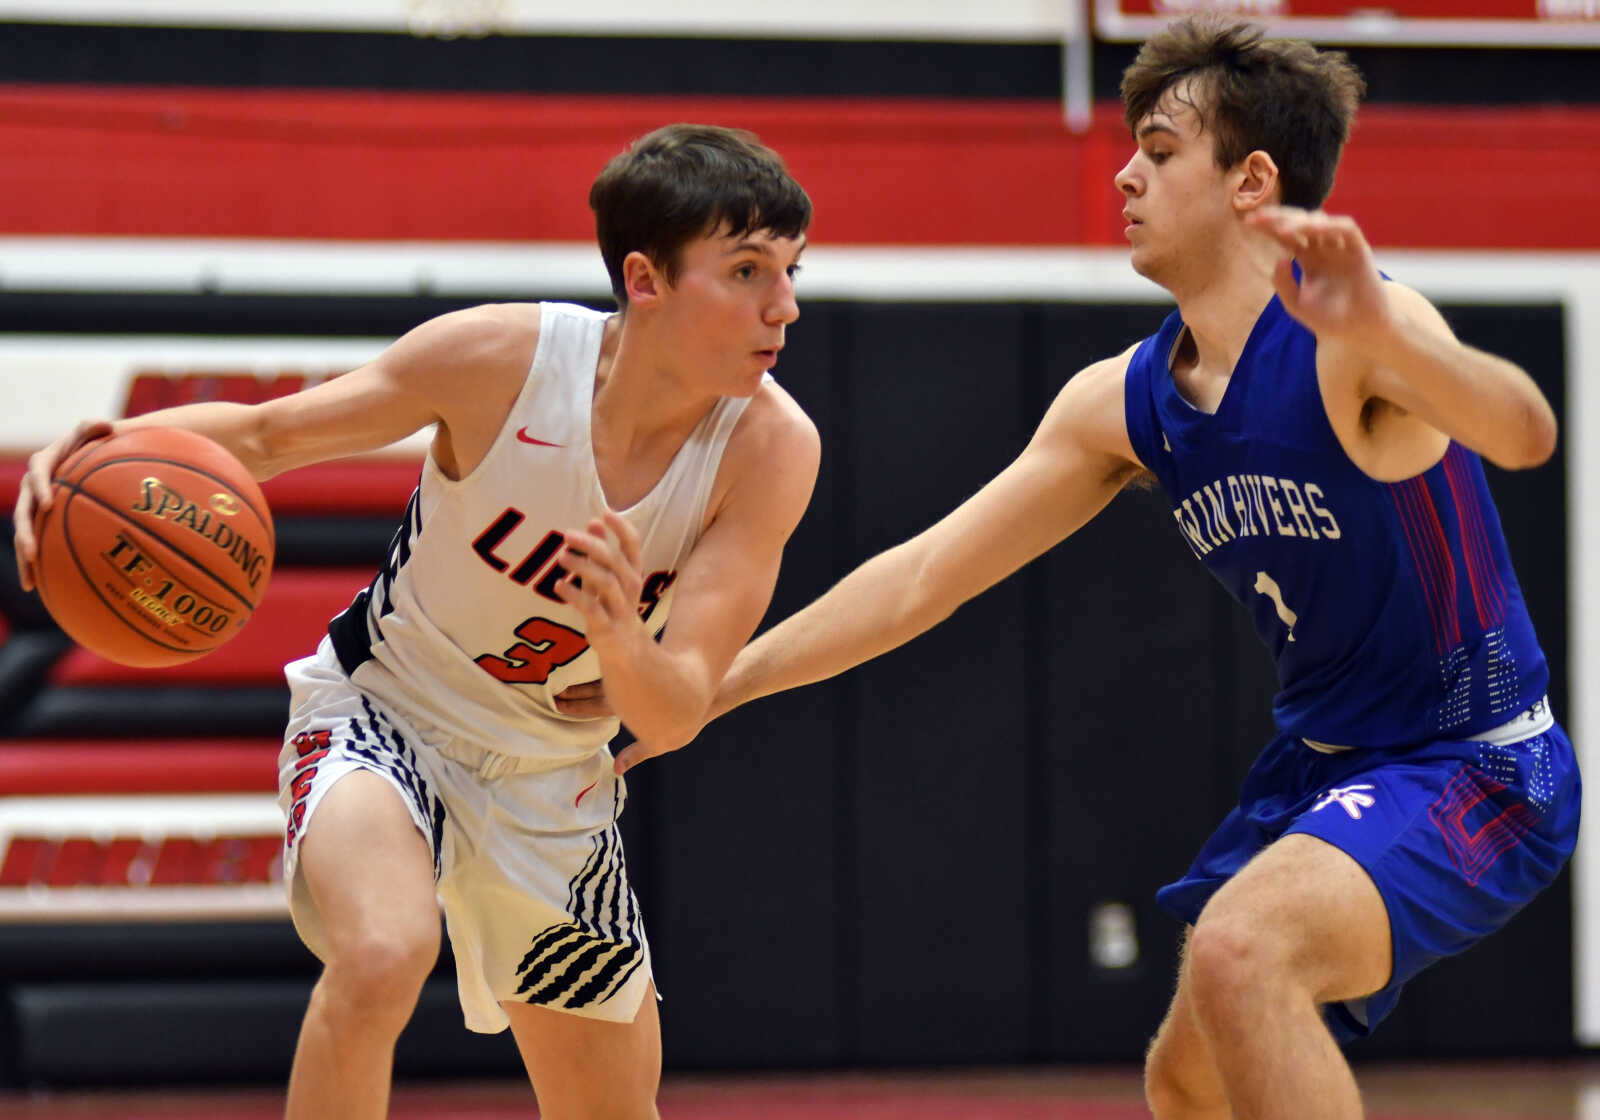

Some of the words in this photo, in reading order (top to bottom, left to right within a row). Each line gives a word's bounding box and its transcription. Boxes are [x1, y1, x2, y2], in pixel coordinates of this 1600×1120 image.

[132, 476, 267, 589] SPALDING
[471, 507, 678, 624] LIS
[1173, 480, 1236, 560] WIN
[1227, 474, 1342, 540] RIVERS
[473, 616, 591, 685] 3
